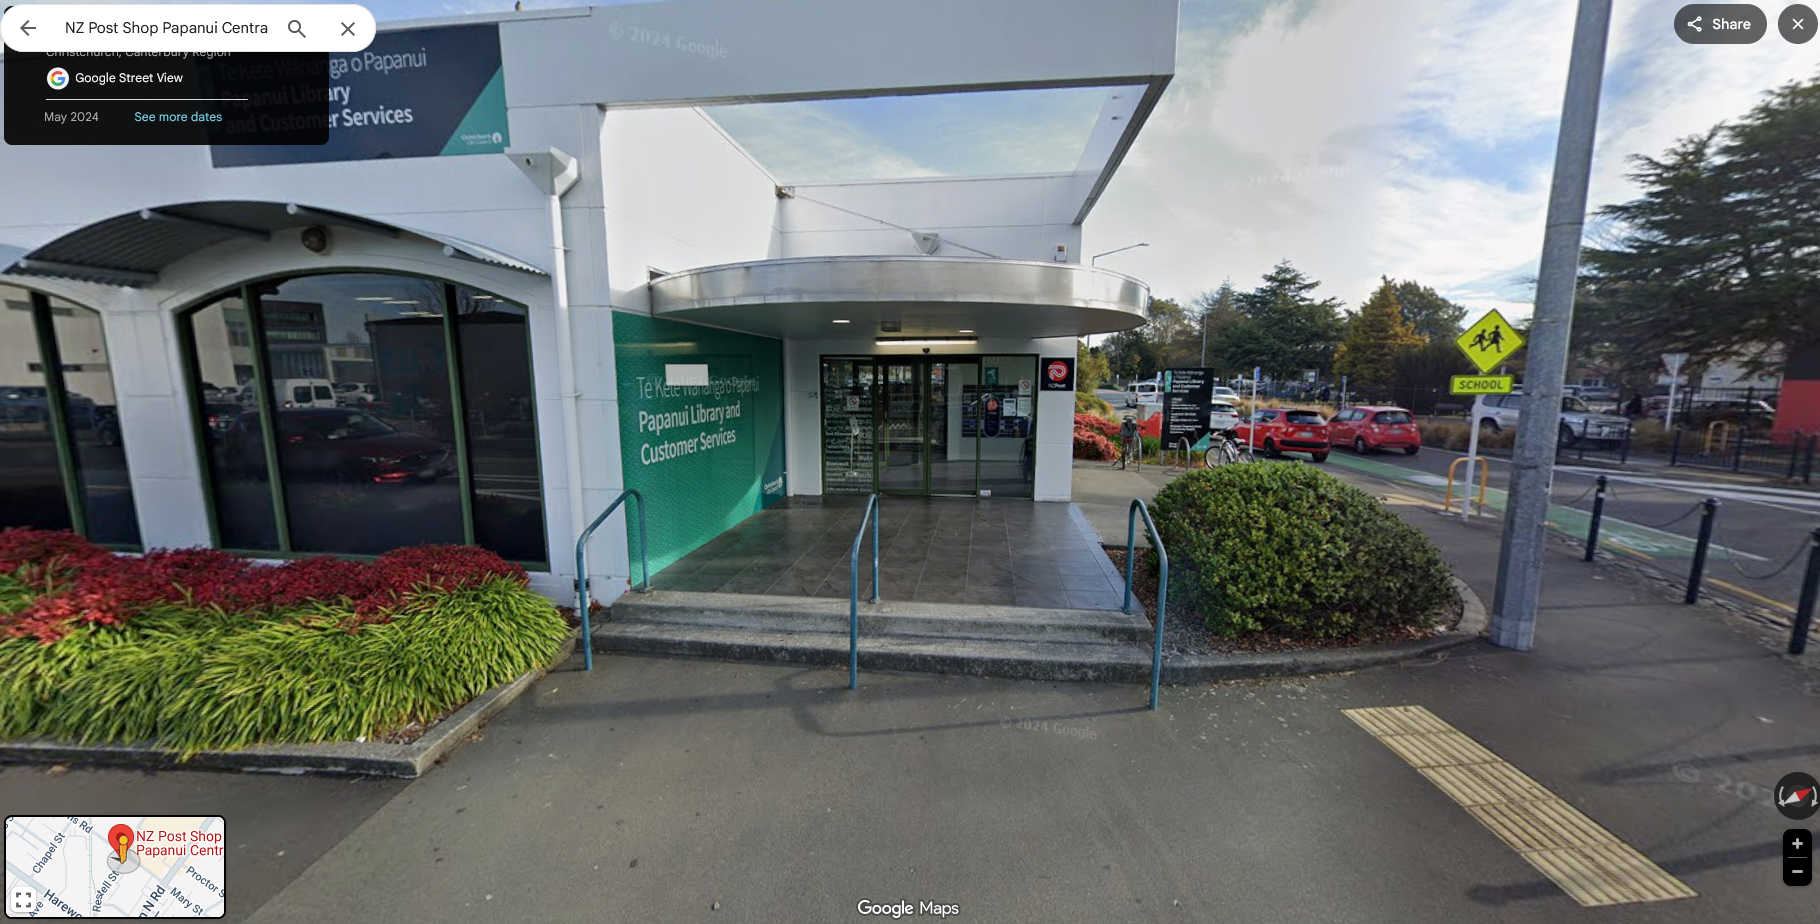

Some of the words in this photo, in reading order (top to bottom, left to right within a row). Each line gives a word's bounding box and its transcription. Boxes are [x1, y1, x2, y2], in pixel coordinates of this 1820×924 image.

[351, 56, 362, 70] o
[364, 48, 427, 75] Papanui
[342, 105, 413, 126] Services
[636, 376, 653, 399] Te
[1459, 380, 1503, 390] SCHOOL
[638, 405, 689, 435] Papanui
[691, 403, 724, 425] Library
[725, 401, 741, 418] and
[641, 437, 699, 465] Customer
[700, 428, 736, 451] Services
